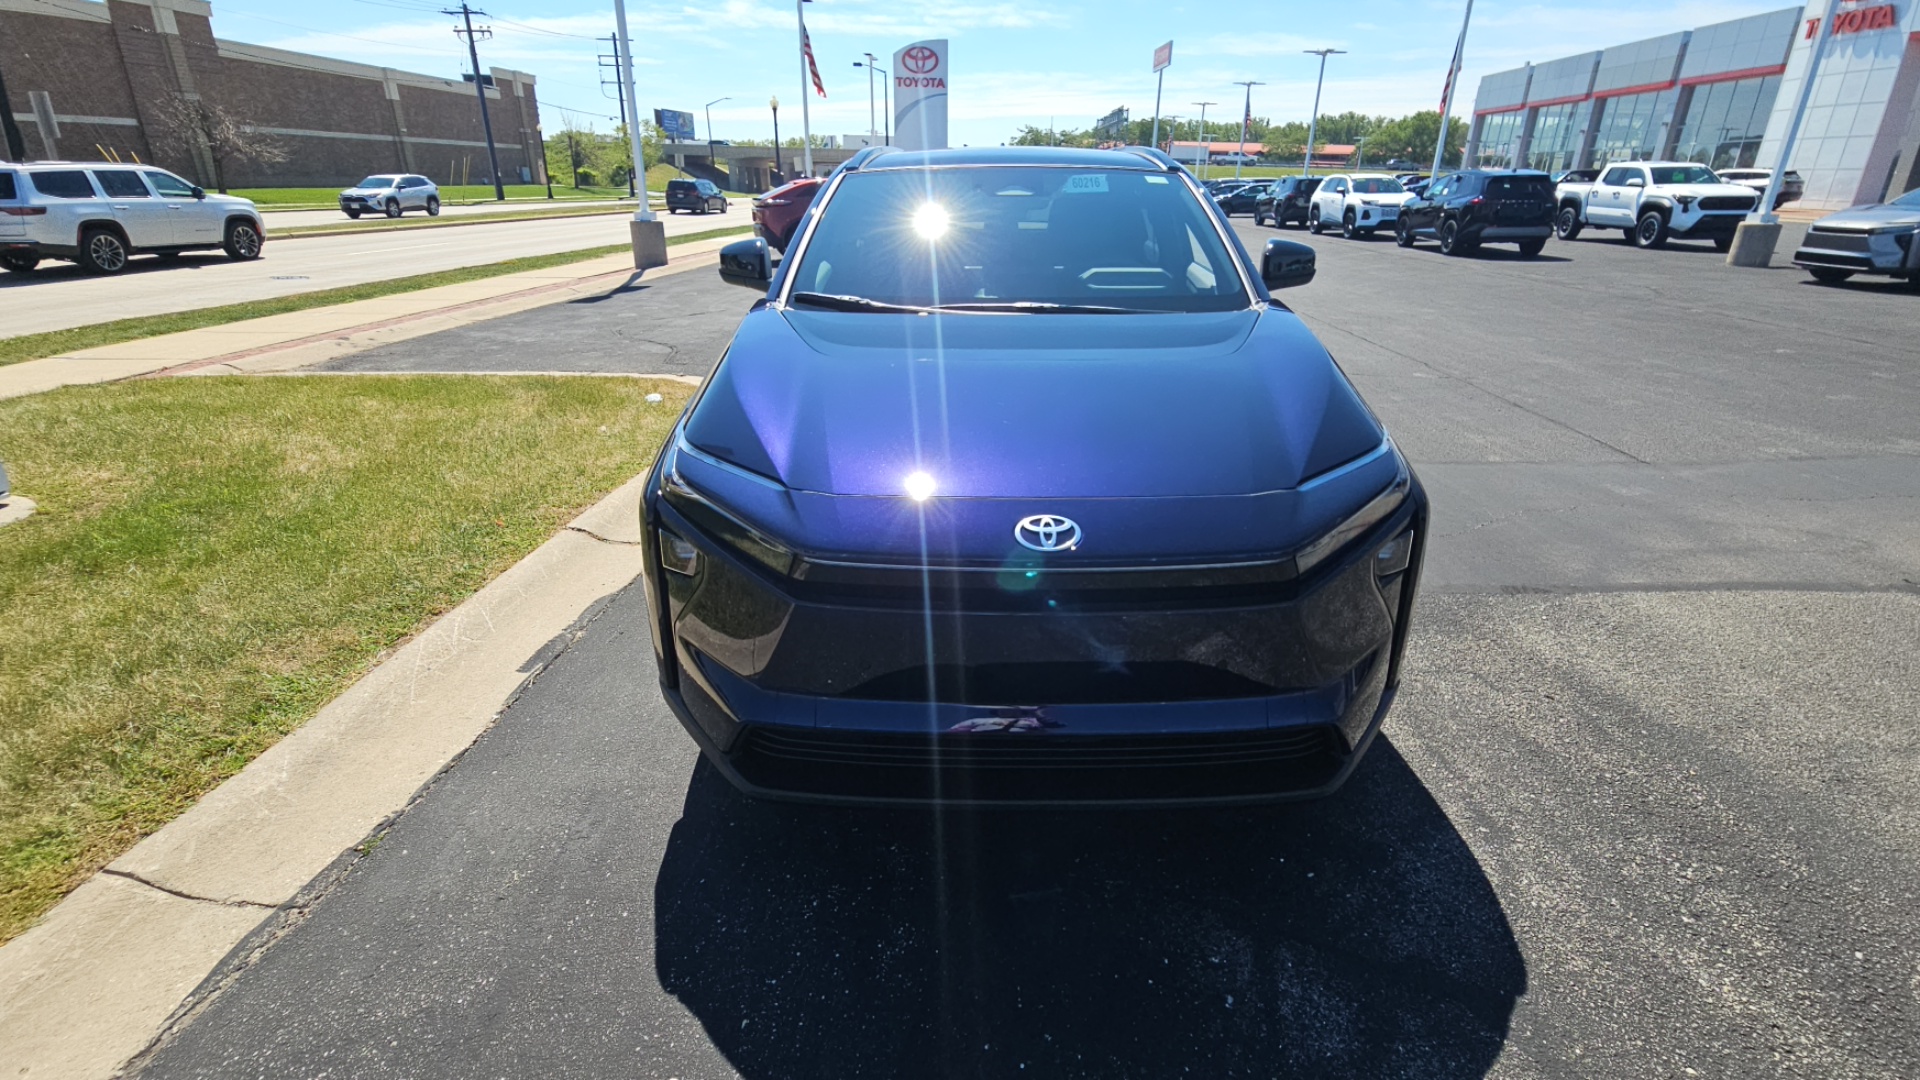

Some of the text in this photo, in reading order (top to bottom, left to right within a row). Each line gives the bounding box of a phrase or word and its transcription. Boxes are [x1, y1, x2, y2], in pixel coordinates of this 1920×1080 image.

[1805, 4, 1894, 39] TYOTA
[895, 77, 946, 88] TOYOTA
[1072, 177, 1101, 189] 60216
